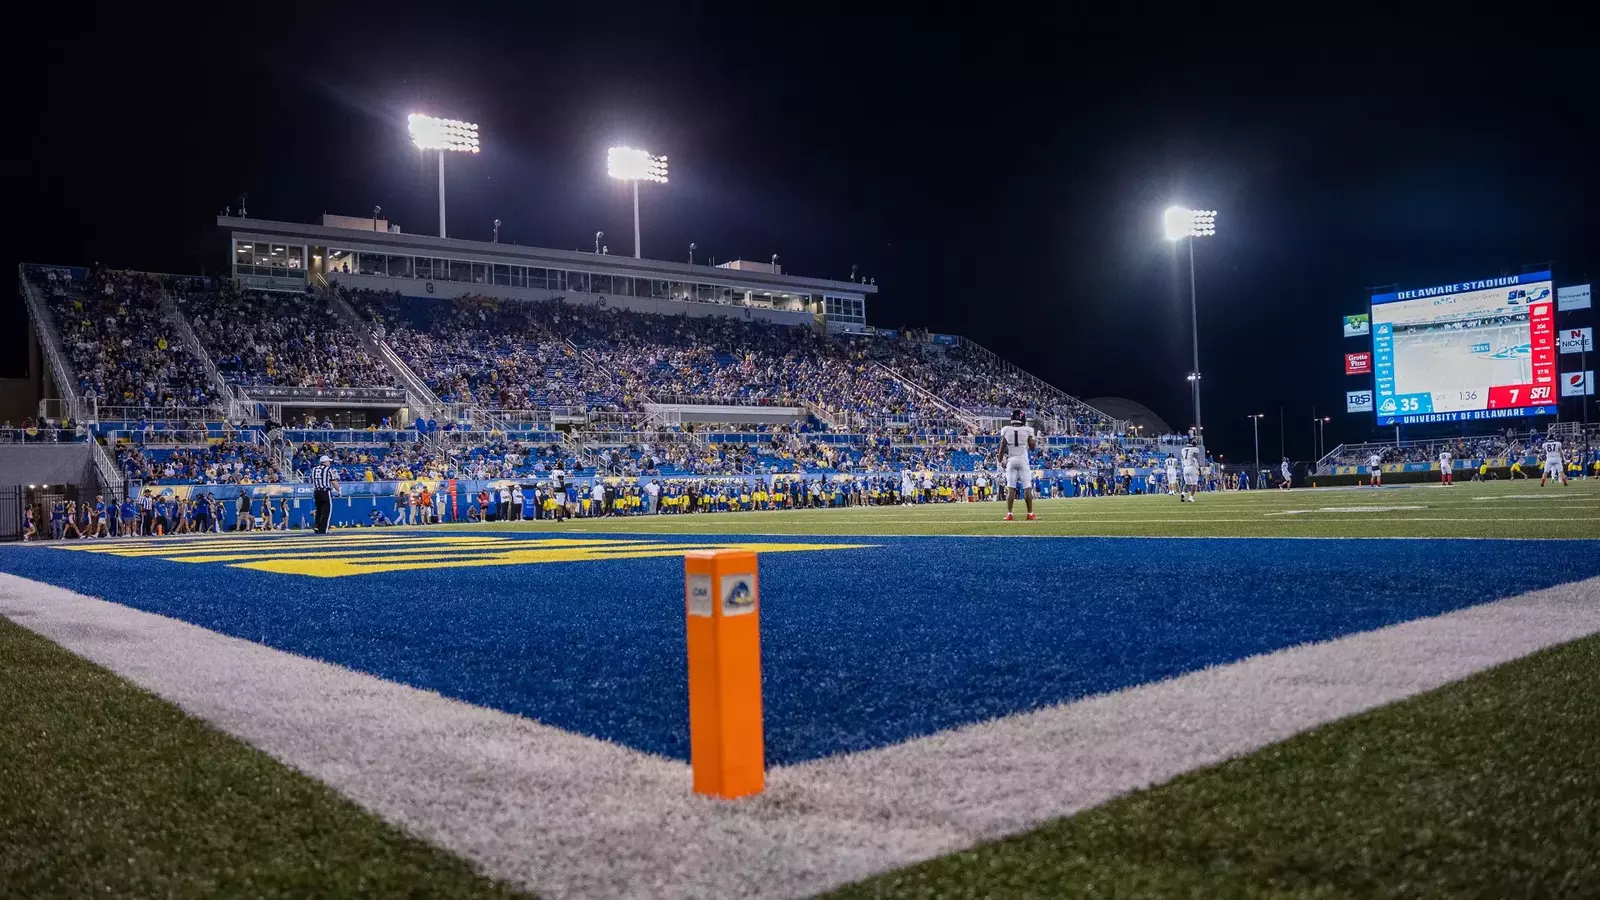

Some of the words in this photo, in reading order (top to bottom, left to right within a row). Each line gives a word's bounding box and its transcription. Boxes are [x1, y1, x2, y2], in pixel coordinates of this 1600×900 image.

[1398, 284, 1459, 300] DELAWARE
[1462, 275, 1519, 290] STADIUM
[1460, 391, 1478, 400] 1:36
[1510, 390, 1519, 404] 7
[1530, 386, 1551, 400] SFU
[1400, 398, 1418, 411] 35
[1404, 412, 1457, 424] UNIVERSITY
[1460, 412, 1471, 420] OF
[1474, 408, 1524, 418] DELAWARE
[1014, 430, 1018, 446] 1
[1185, 449, 1189, 459] 7
[1546, 444, 1556, 452] 87
[316, 468, 322, 478] R
